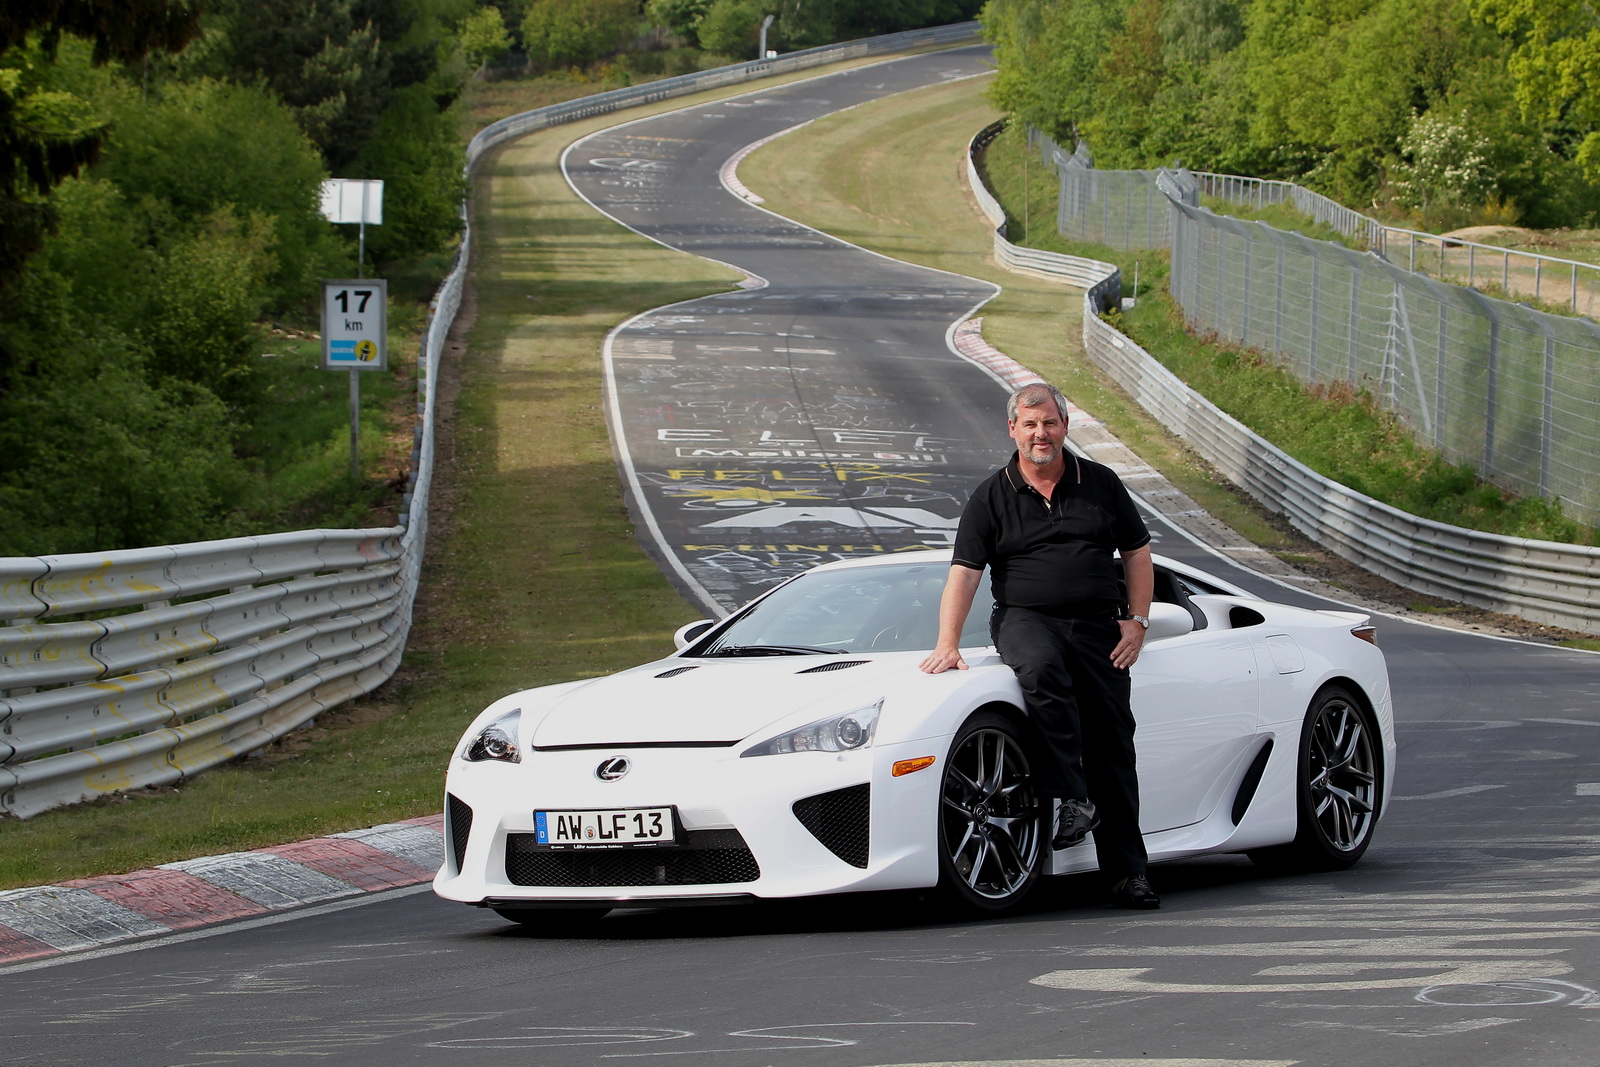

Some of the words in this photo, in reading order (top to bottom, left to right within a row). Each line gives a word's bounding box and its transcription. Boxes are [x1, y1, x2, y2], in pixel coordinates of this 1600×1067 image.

[334, 290, 372, 313] 17
[344, 319, 363, 331] km
[666, 468, 935, 484] FELIX
[683, 544, 955, 553] KUNHA
[556, 815, 582, 840] AW
